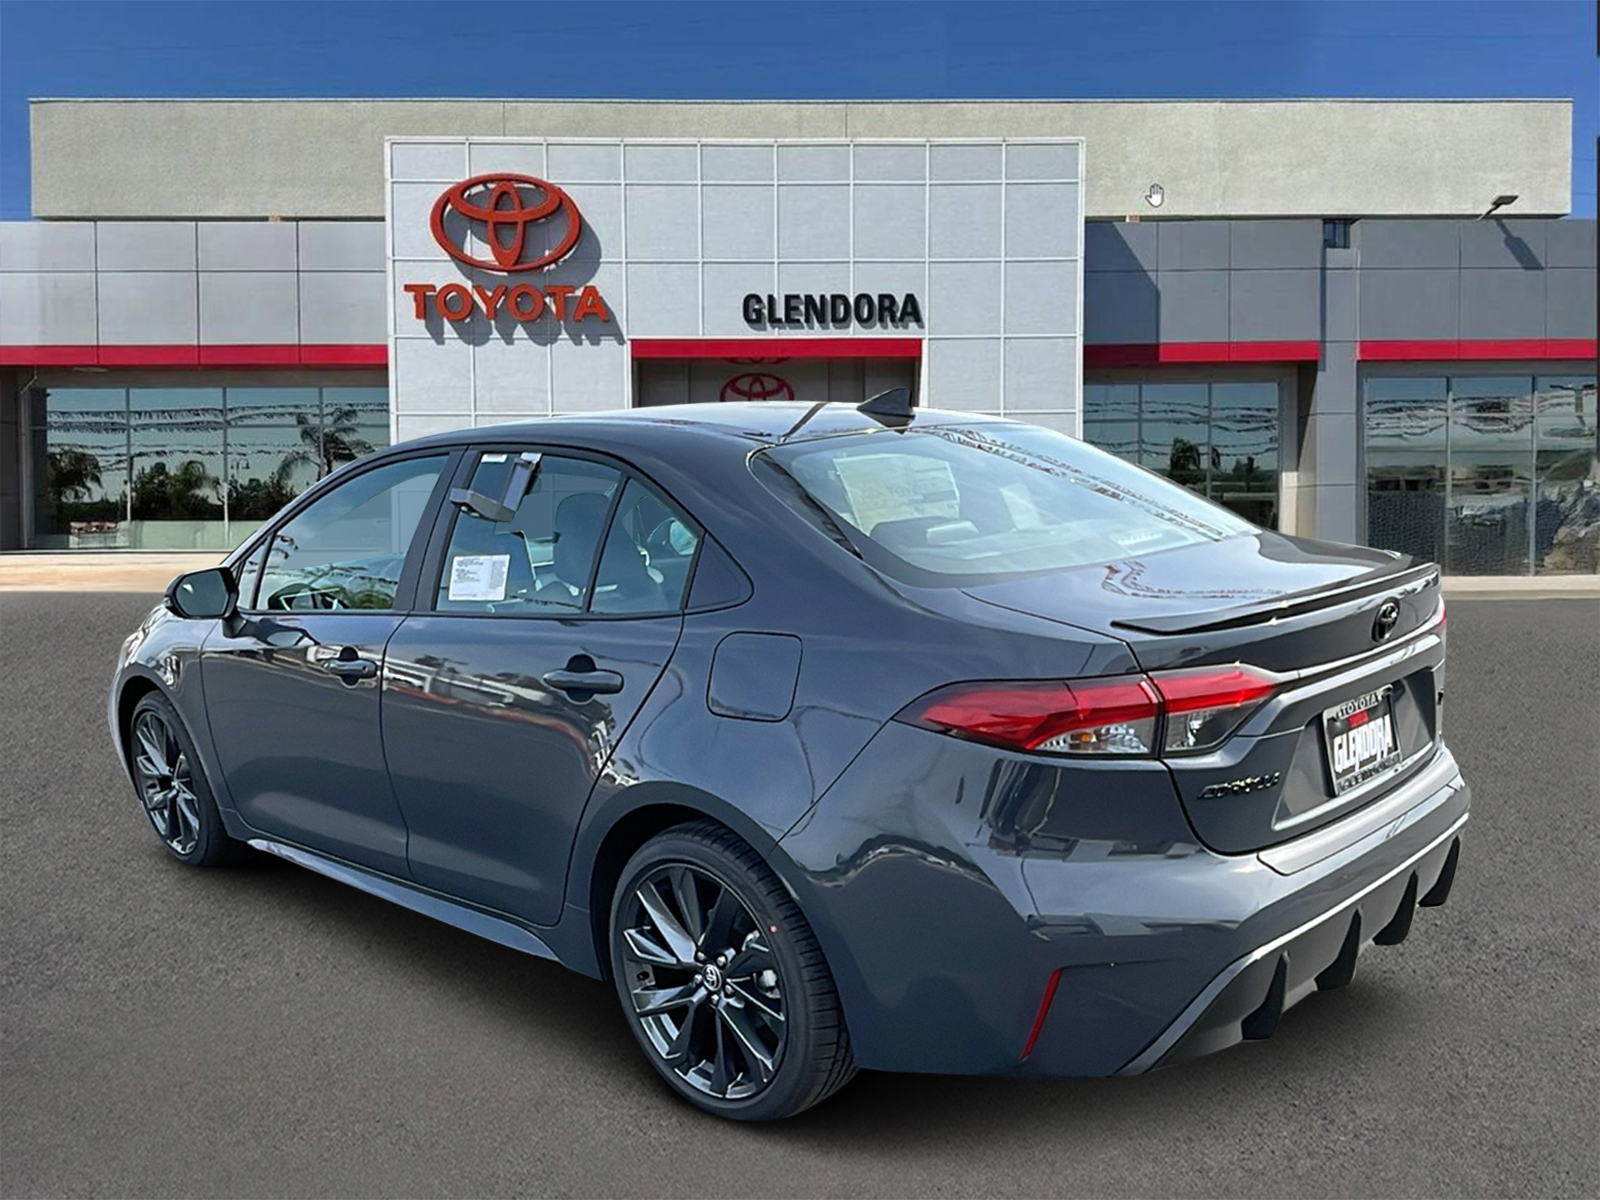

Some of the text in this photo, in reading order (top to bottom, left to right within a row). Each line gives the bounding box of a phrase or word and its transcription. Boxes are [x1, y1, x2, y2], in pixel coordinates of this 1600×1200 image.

[404, 283, 610, 322] TOYOTA
[743, 293, 922, 325] GLENDORA
[1340, 692, 1379, 716] TOYOTA
[1333, 714, 1393, 773] GLENDORA
